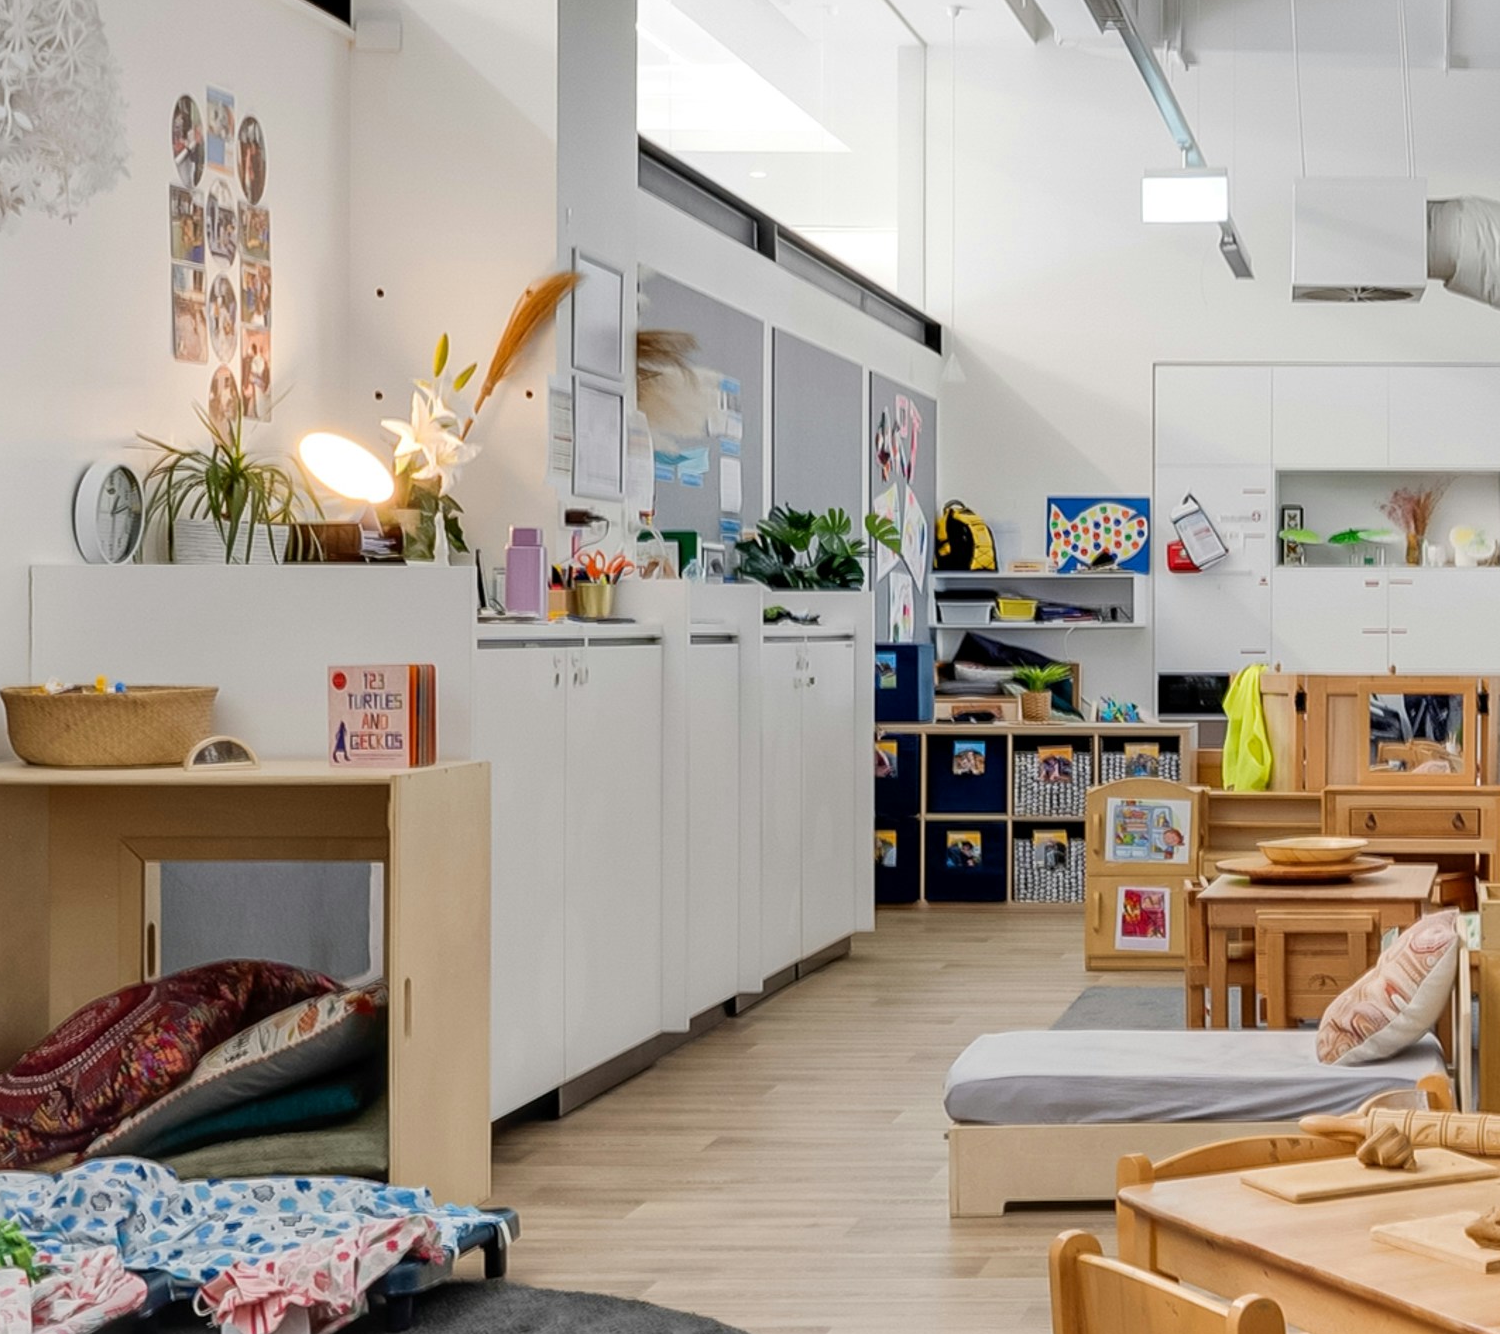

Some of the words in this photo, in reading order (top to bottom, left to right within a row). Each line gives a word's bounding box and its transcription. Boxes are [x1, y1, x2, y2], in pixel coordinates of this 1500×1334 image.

[363, 671, 385, 690] 123
[347, 692, 403, 710] TURTLES
[361, 712, 389, 730] AND
[349, 732, 404, 751] GECKOS
